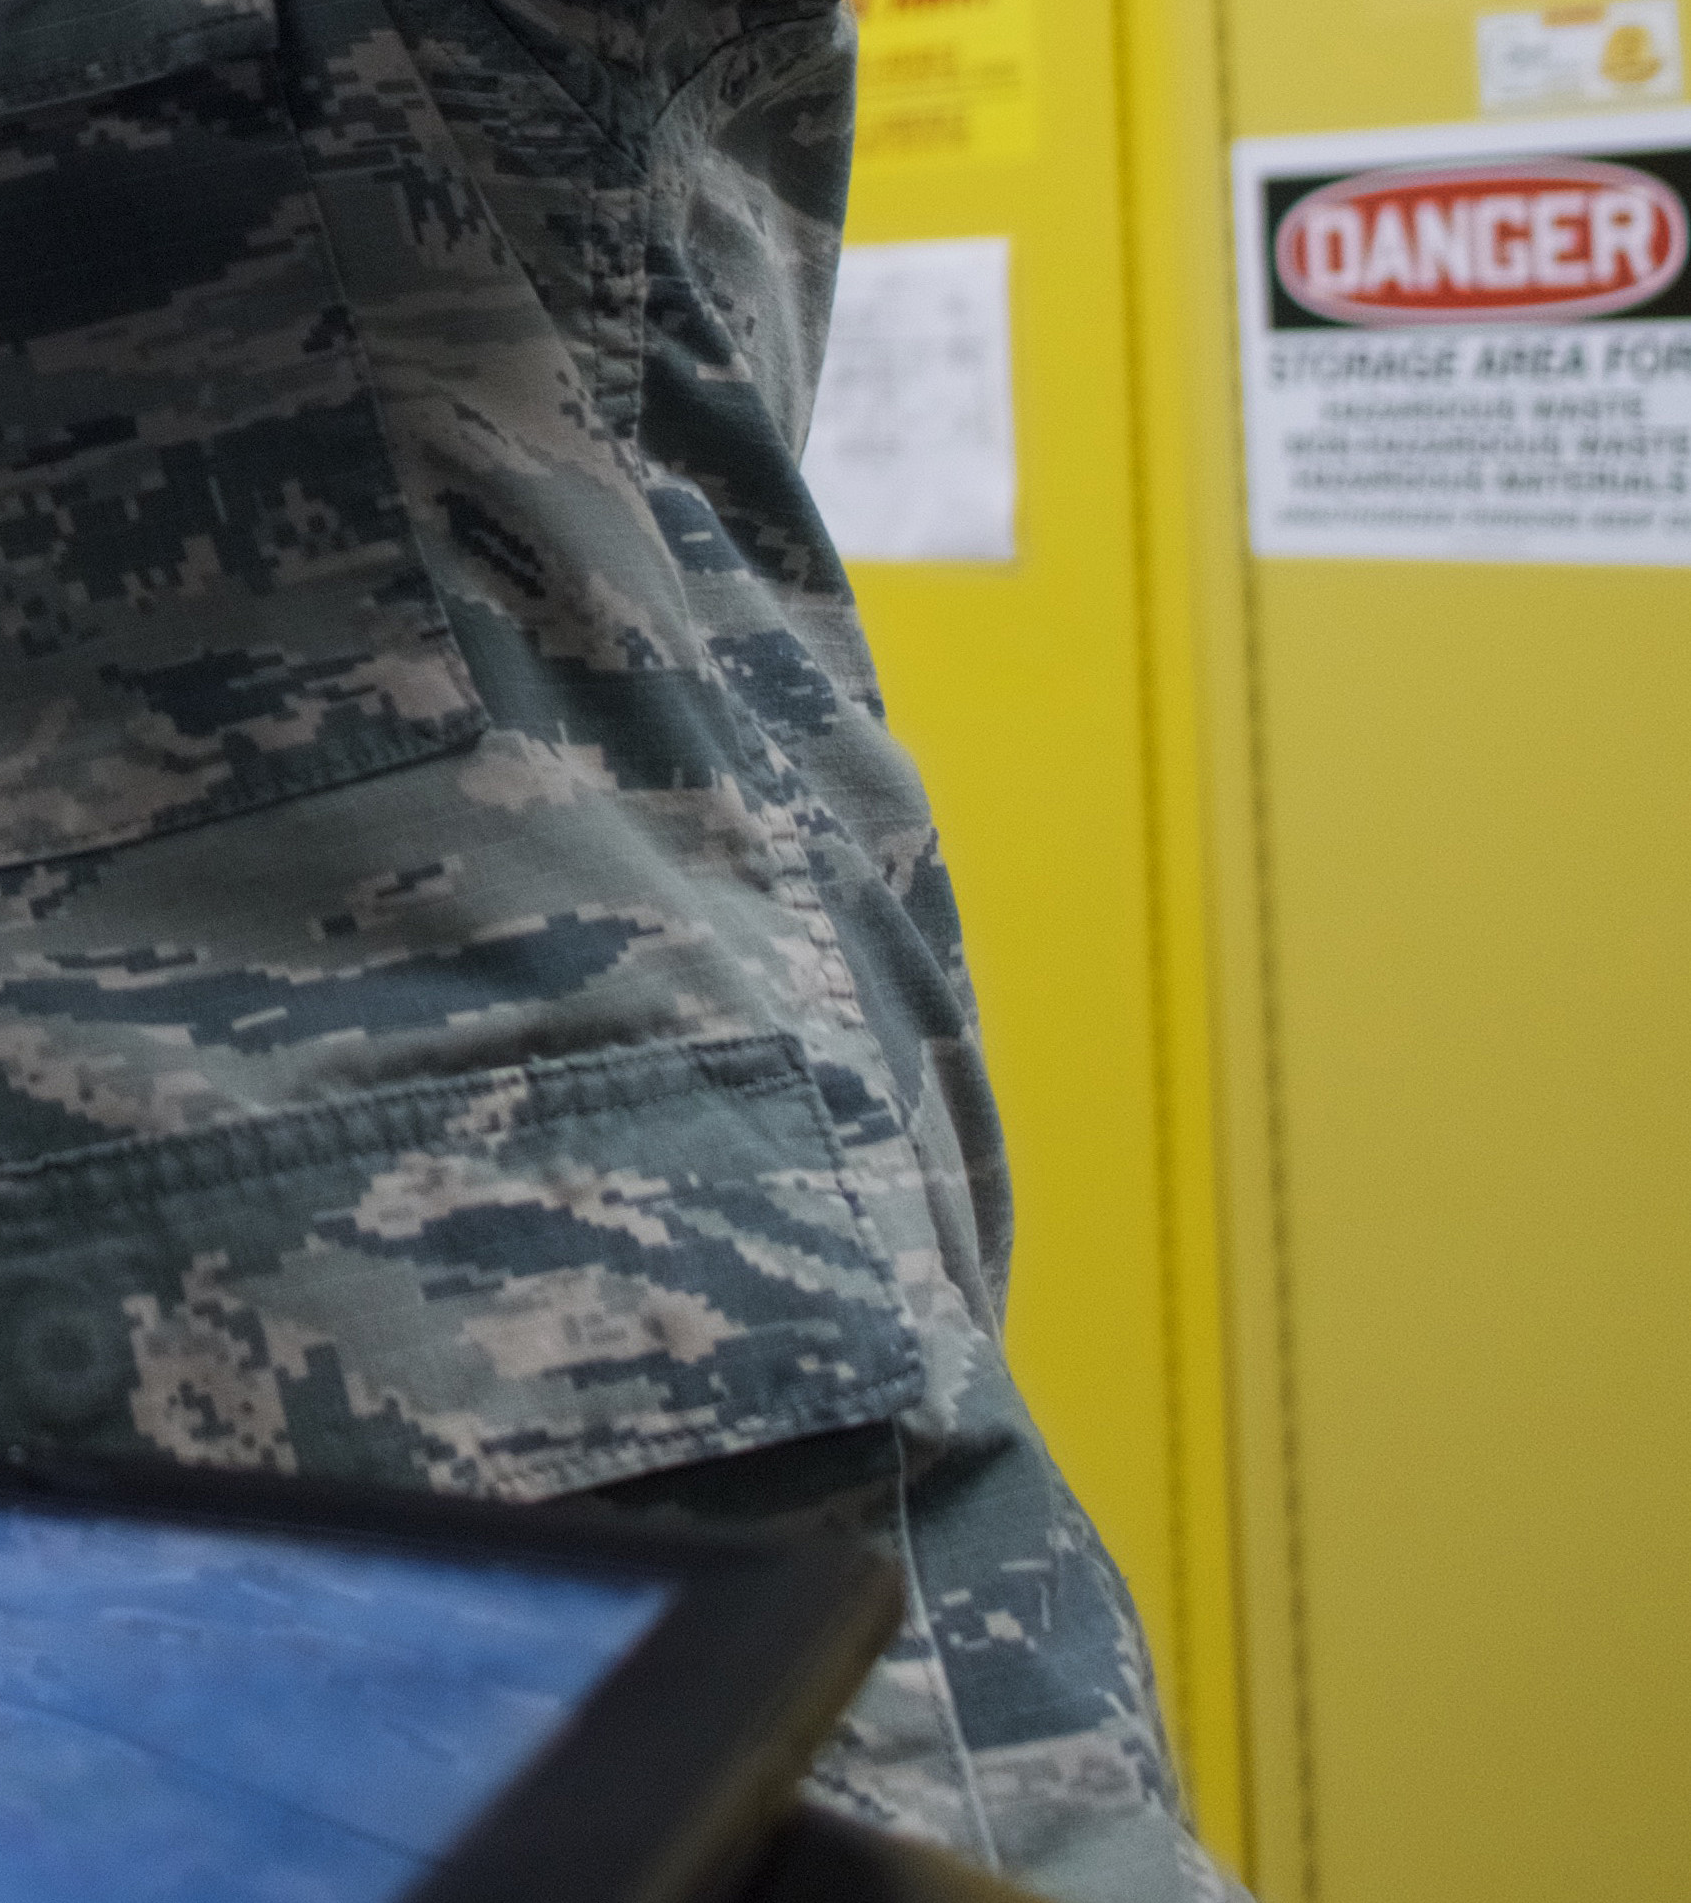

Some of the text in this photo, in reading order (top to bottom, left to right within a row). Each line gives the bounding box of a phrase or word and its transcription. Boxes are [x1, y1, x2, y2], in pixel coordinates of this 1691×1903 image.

[1306, 185, 1653, 299] DANGER
[1269, 349, 1459, 385] STORAGE
[1474, 344, 1587, 379] AREA
